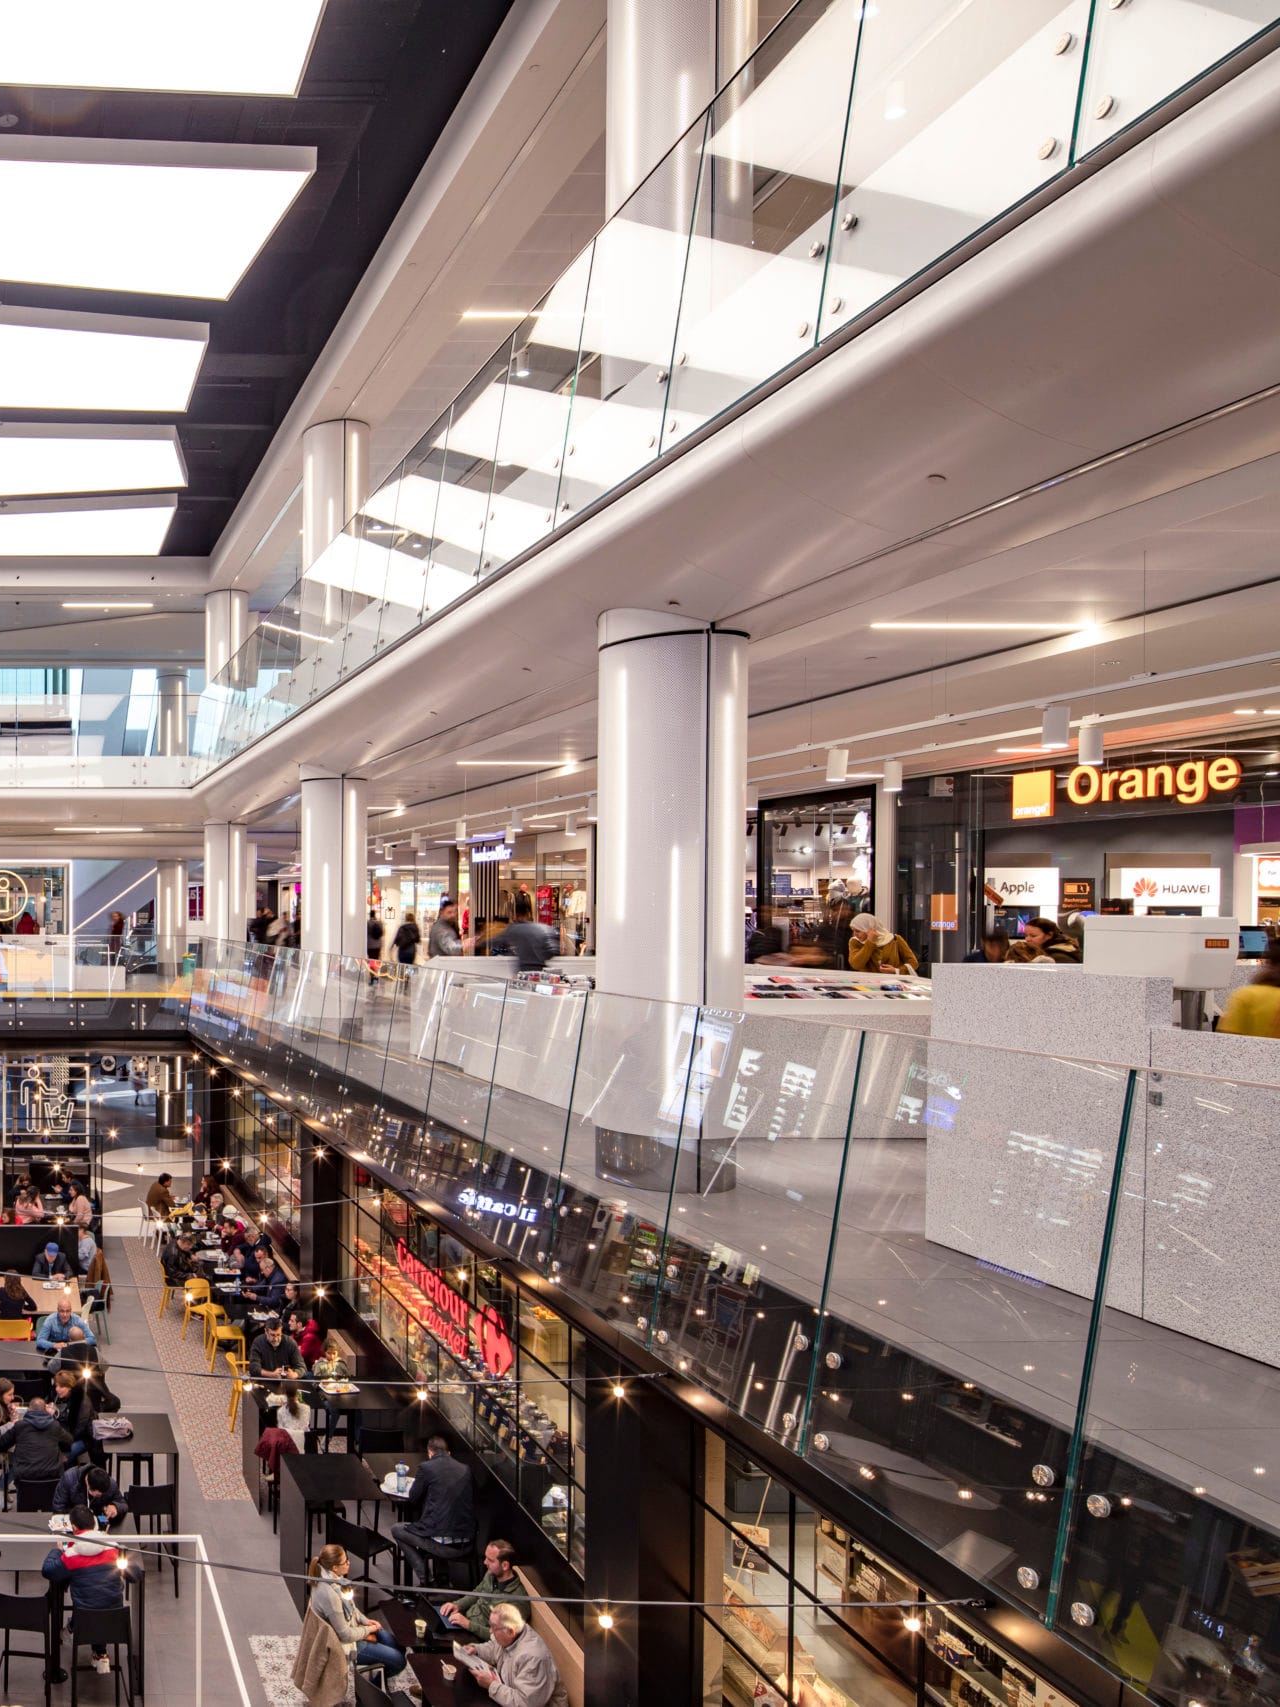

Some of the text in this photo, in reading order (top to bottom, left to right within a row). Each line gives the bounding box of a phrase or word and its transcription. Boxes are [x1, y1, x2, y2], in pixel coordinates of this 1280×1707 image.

[1067, 757, 1242, 805] Orange
[1014, 803, 1050, 816] orange
[999, 881, 1036, 895] Apple
[1162, 884, 1211, 894] HUAWEI
[397, 1237, 469, 1329] Carrefour
[423, 1307, 469, 1360] market
